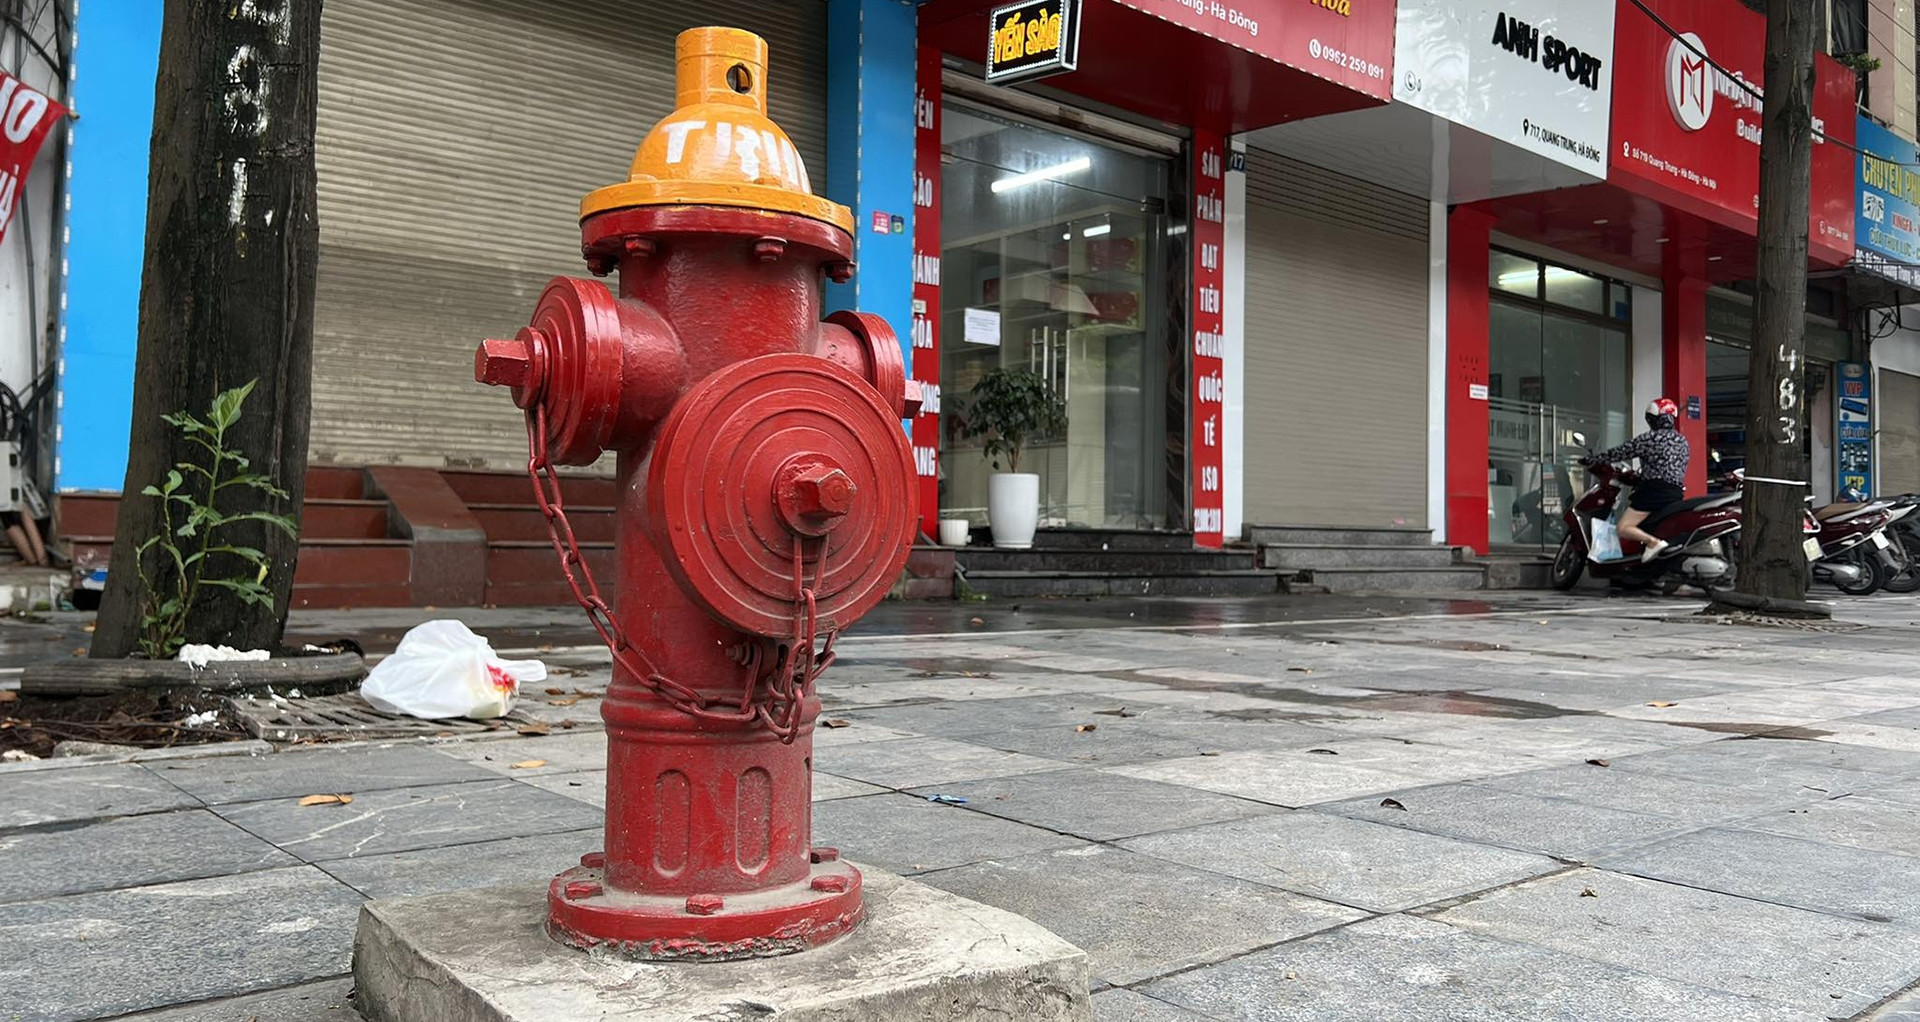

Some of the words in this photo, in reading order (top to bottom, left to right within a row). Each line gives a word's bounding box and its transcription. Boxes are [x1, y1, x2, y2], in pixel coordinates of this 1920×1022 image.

[994, 12, 1025, 63] YẾN
[1025, 8, 1061, 55] SÀO
[1229, 9, 1258, 36] Đông
[1323, 45, 1347, 67] 0962
[1349, 56, 1366, 74] 259
[1367, 63, 1384, 80] 091
[1492, 12, 1539, 62] ANH
[1542, 35, 1602, 90] SPORT
[1541, 128, 1560, 147] QUANG
[1863, 149, 1902, 198] CHUYÊN
[1202, 243, 1218, 273] ĐẠT
[1200, 284, 1219, 313] TIÊU
[1199, 370, 1222, 404] QUỐC
[1203, 413, 1215, 447] TẾ
[1202, 466, 1218, 491] ISO
